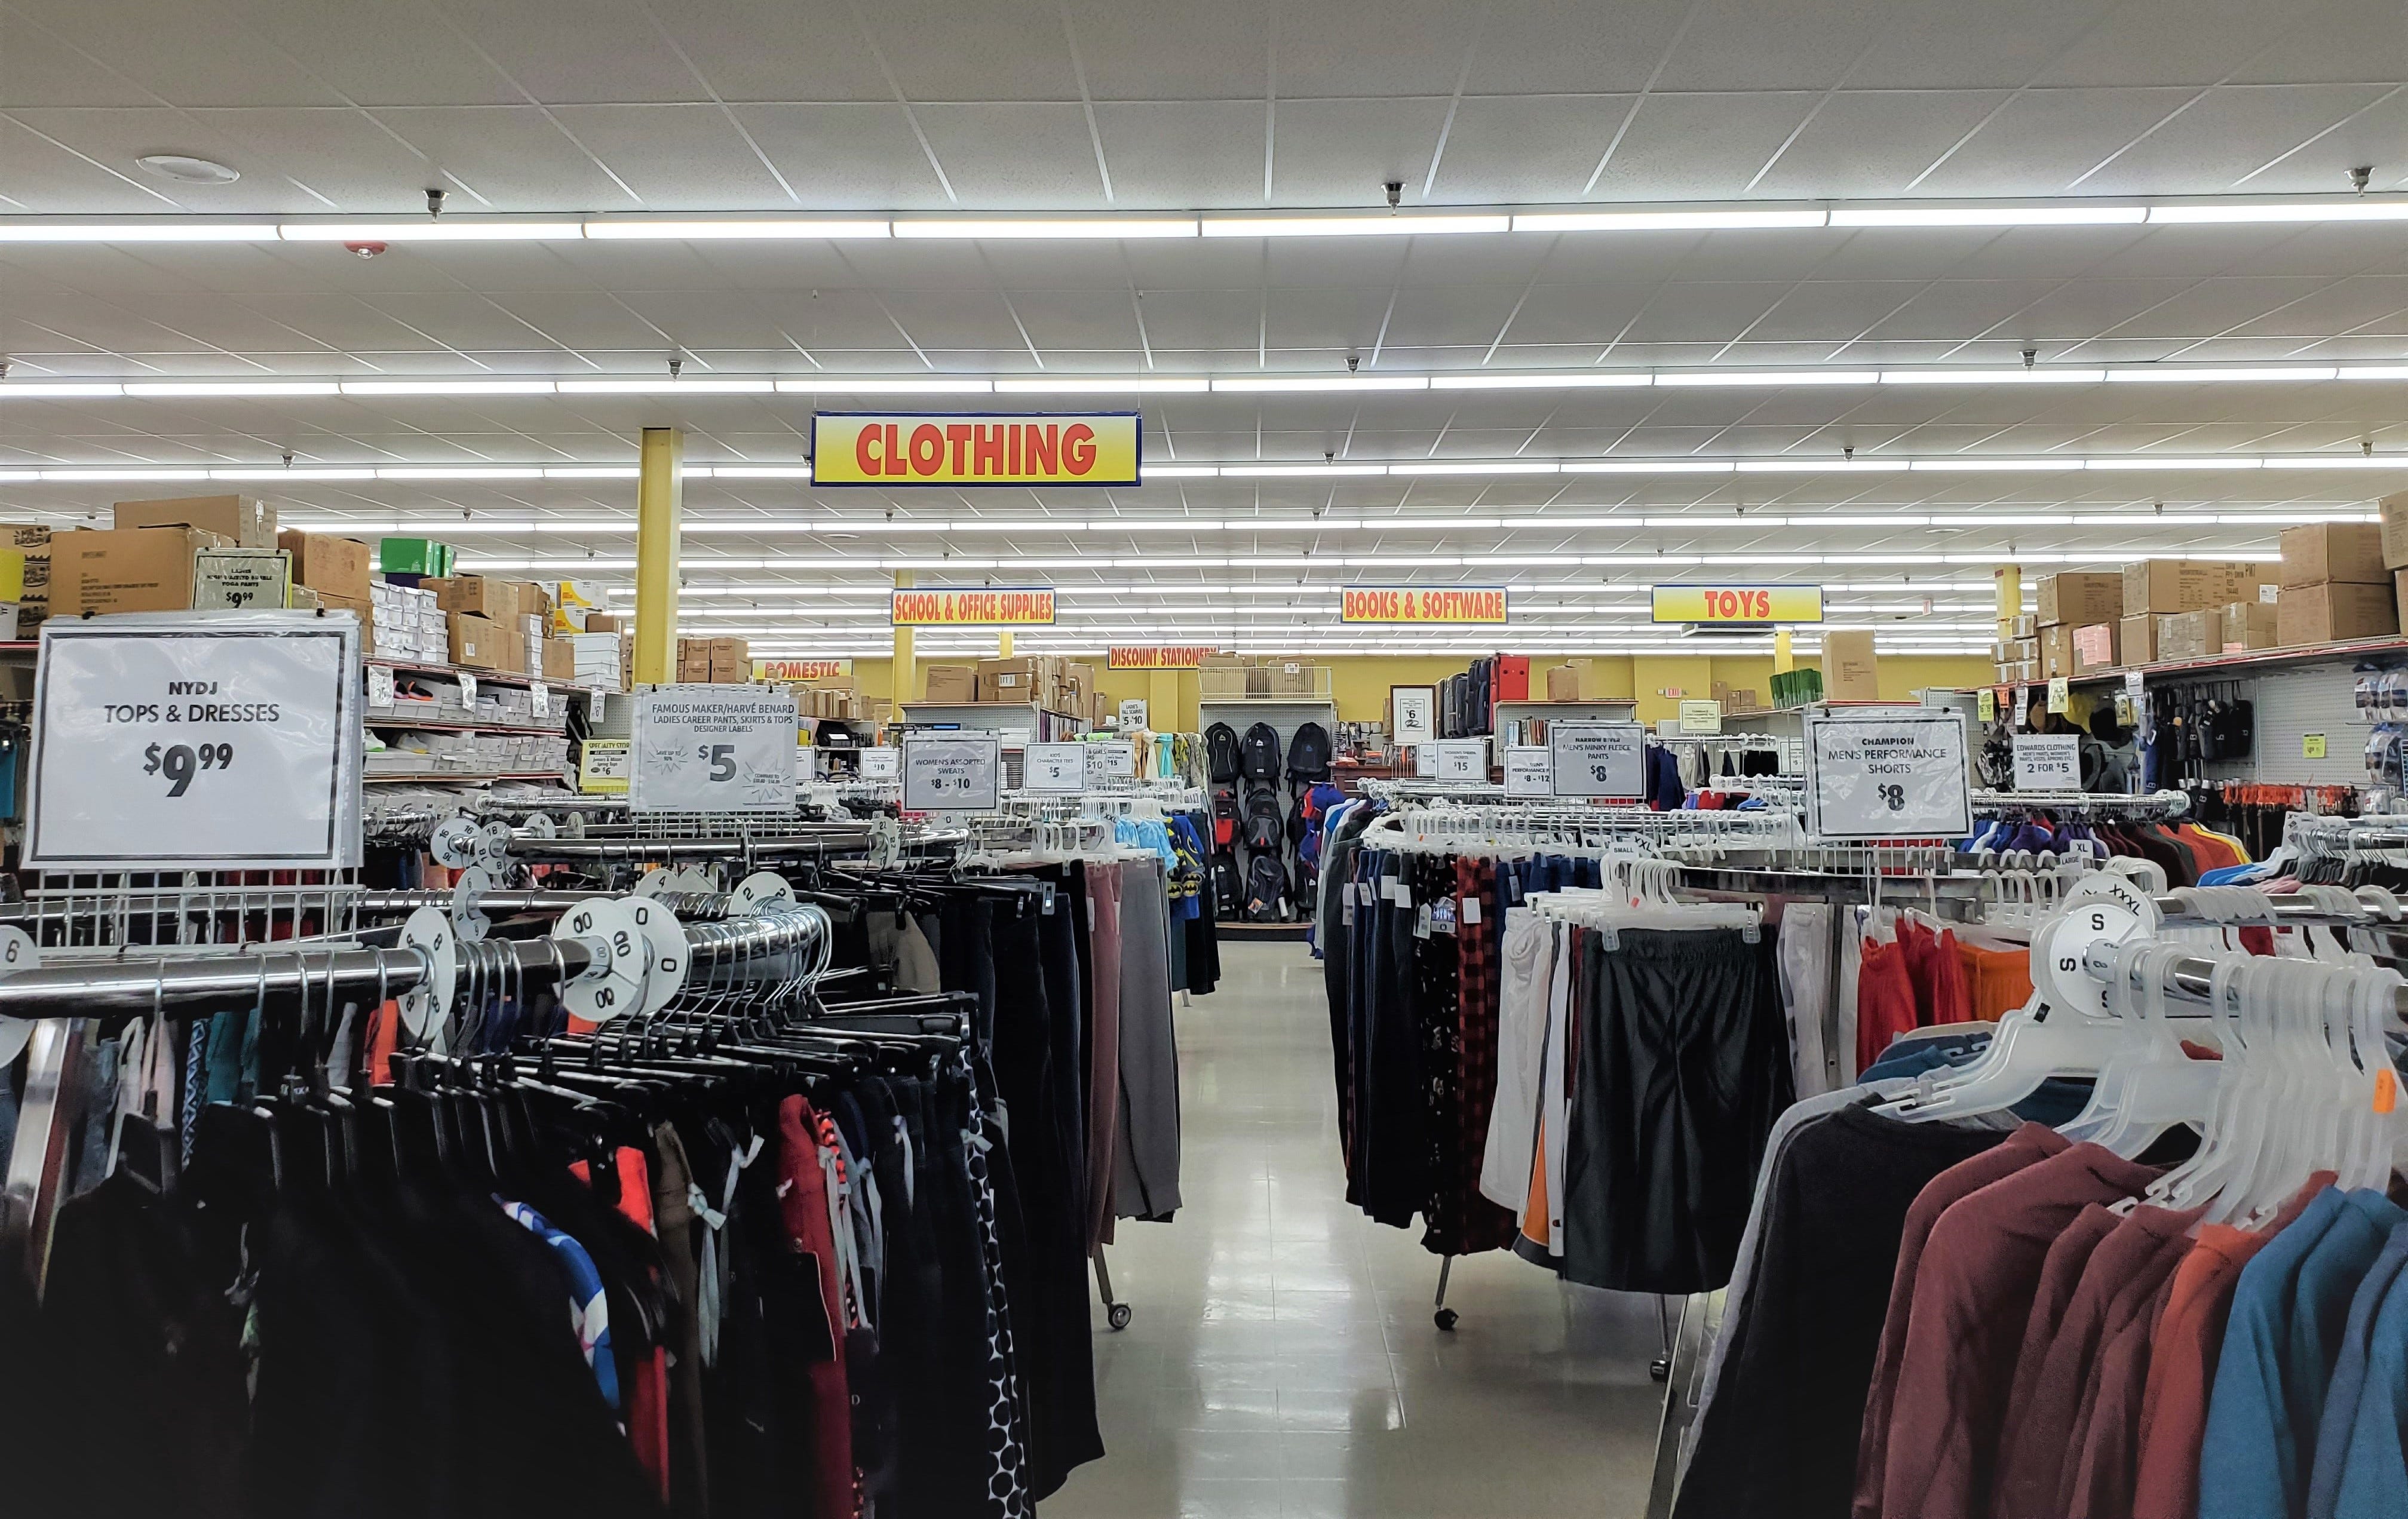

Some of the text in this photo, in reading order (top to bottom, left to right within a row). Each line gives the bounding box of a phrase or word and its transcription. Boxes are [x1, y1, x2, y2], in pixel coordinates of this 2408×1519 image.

[855, 423, 1097, 476] CLOTHING
[895, 593, 1052, 621] SCHOOL & OFFICE SUPPLIES
[1346, 591, 1502, 619] BOOKS & SOFTWARE
[1704, 590, 1770, 618] TOYS
[1111, 648, 1158, 667] DISCOUNT
[168, 681, 218, 695] NYDJ
[104, 704, 280, 723] TOPS & DRESSES
[652, 702, 795, 715] FAMOUS MAKER/HARVÉ BENARD
[713, 716, 739, 725] PANTS,
[774, 716, 793, 725] TOPS
[1828, 748, 1946, 760] MEN'S PERFORMANCE
[698, 744, 737, 781] $5
[1087, 760, 1103, 769] $10
[1454, 762, 1468, 771] $15
[1868, 763, 1911, 774] SHORTS
[2027, 763, 2035, 773] 2
[2038, 763, 2054, 772] FOR
[1050, 766, 1060, 777] $5
[1590, 765, 1607, 782] $8
[931, 778, 941, 789] $8
[954, 778, 970, 789] $10
[1878, 782, 1905, 811] $8
[465, 825, 474, 834] 16
[486, 826, 498, 836] 18
[2077, 843, 2088, 852] XL
[2062, 857, 2079, 865] LARGE
[467, 877, 472, 888] 6
[658, 876, 667, 888] 4
[743, 886, 755, 901] 2
[2108, 883, 2141, 916] XXXL
[636, 907, 648, 925] 0
[2091, 913, 2105, 930] S
[434, 932, 443, 951] 8
[5, 940, 20, 963] 6
[2060, 958, 2076, 972] S
